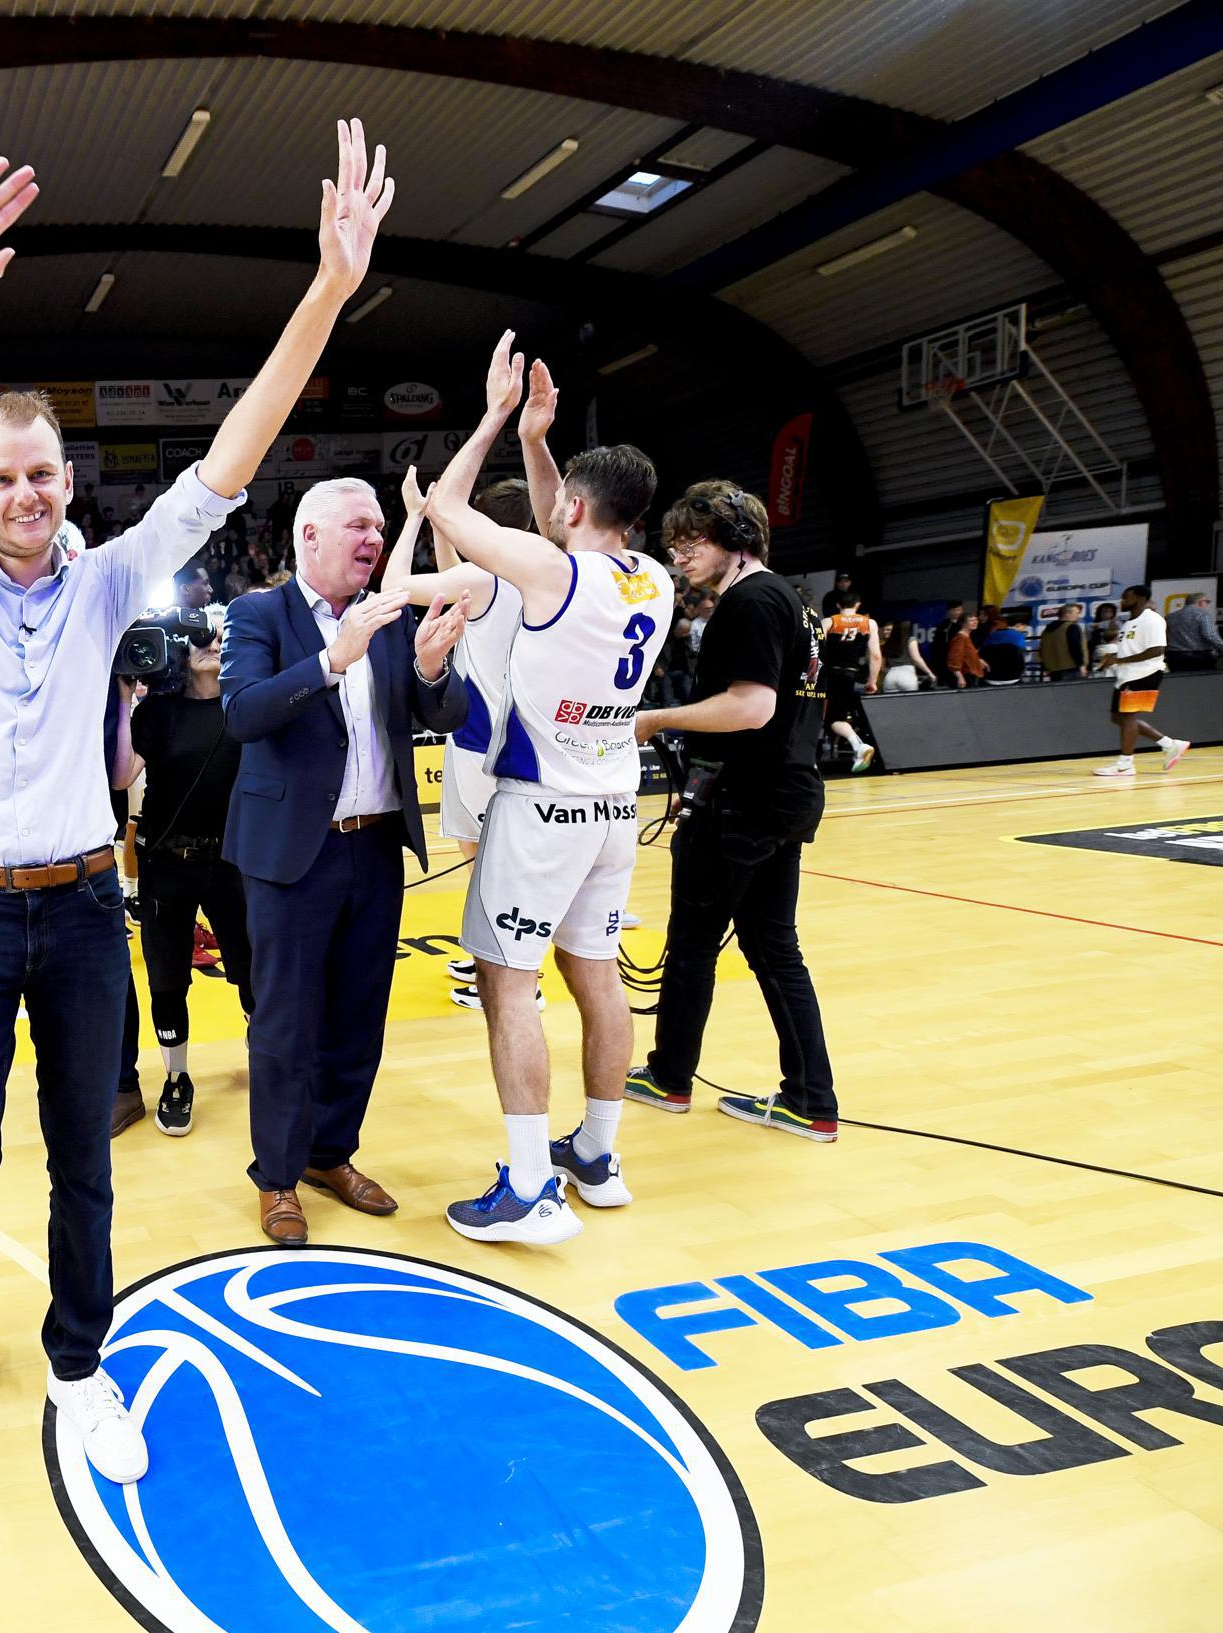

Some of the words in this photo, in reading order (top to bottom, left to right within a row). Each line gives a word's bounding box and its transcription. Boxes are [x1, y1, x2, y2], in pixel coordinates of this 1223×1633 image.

[390, 392, 434, 405] SPALDING
[778, 447, 797, 516] BINGOAL
[841, 628, 858, 640] 13
[614, 612, 656, 690] 3
[585, 705, 614, 719] DB
[534, 803, 587, 824] Van
[496, 907, 552, 941] dps
[163, 1030, 177, 1040] NBA
[614, 1241, 1095, 1371] FIBA
